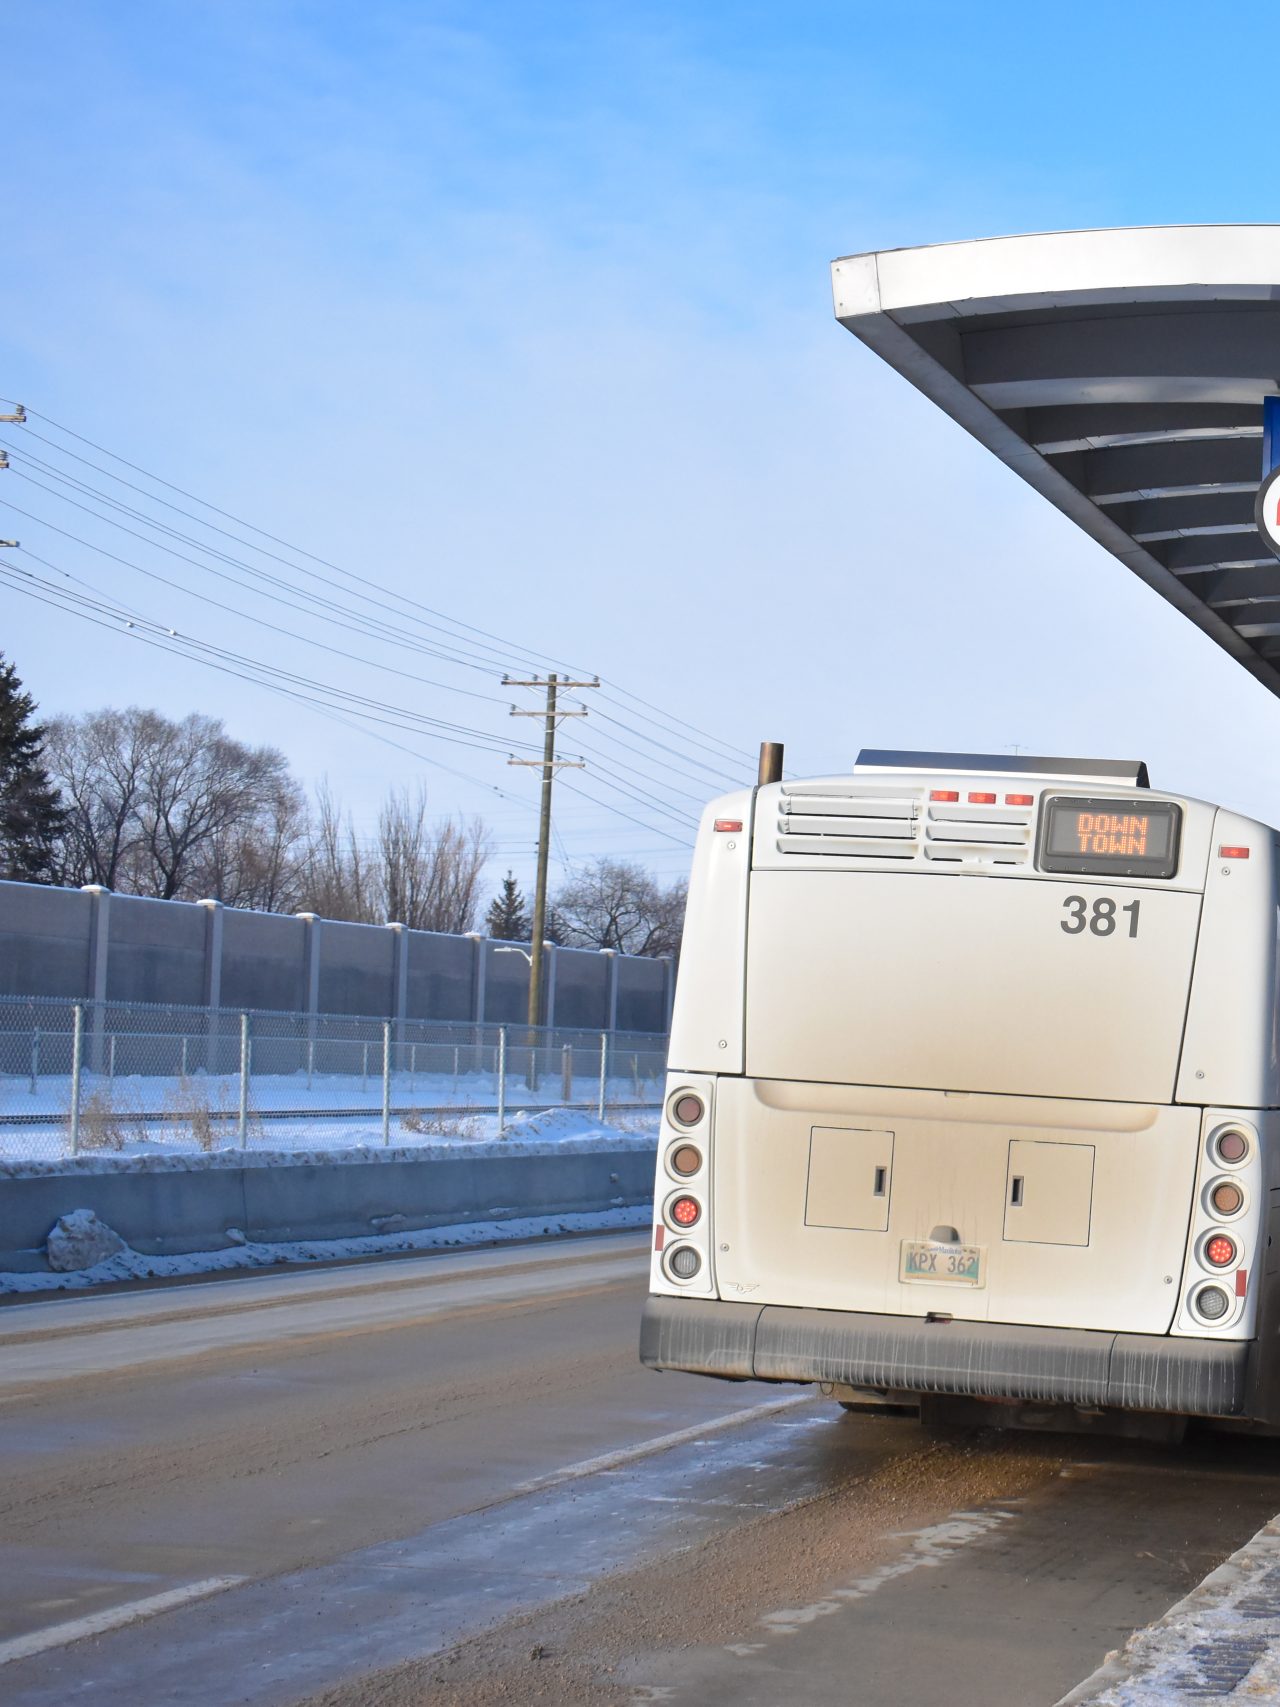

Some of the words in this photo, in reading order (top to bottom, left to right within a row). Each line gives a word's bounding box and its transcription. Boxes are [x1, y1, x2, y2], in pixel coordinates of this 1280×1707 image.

[1077, 813, 1149, 836] DOWN
[1076, 832, 1147, 856] TOWN
[1060, 894, 1142, 939] 381
[909, 1251, 938, 1272] KPX
[947, 1254, 977, 1275] 362
